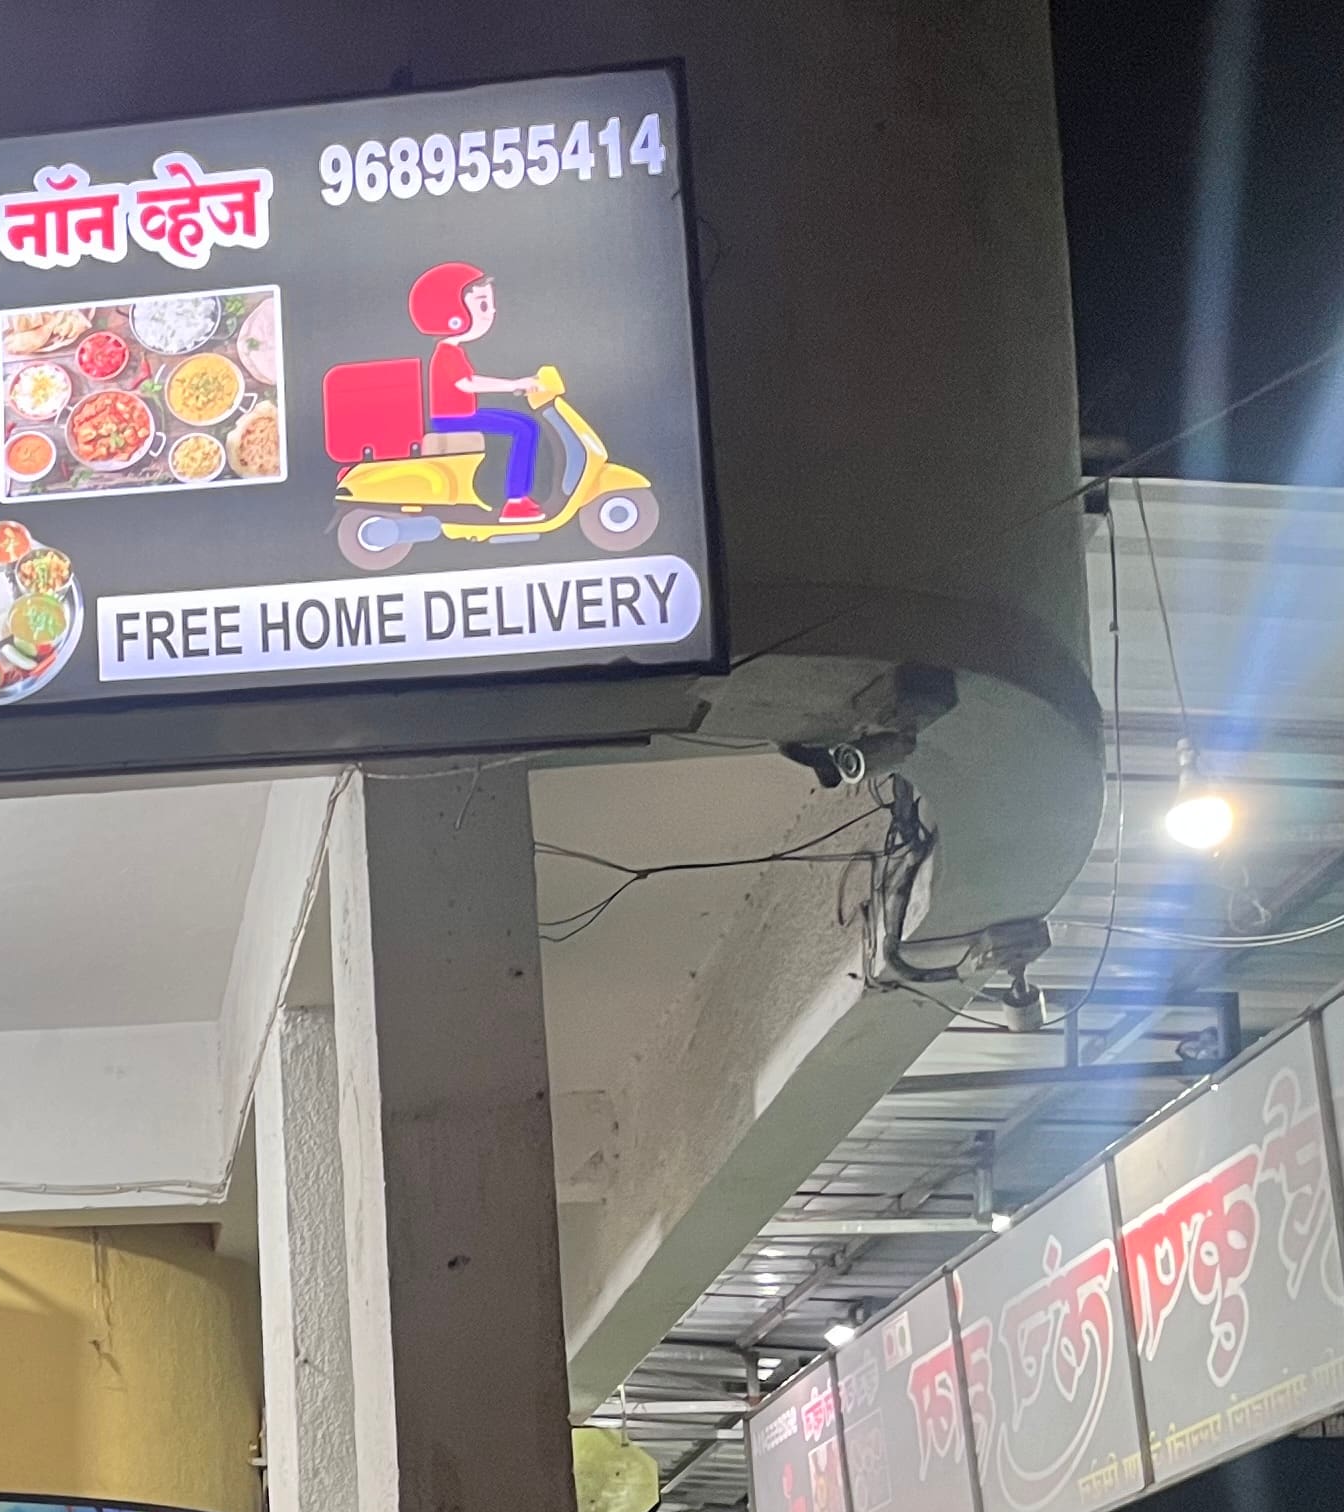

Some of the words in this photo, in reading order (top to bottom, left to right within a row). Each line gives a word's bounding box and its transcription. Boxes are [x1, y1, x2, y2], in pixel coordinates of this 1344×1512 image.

[320, 113, 667, 206] 9689555414
[5, 175, 118, 260] नॉन
[137, 158, 263, 260] व्हेज
[114, 606, 243, 663] FREE
[261, 590, 405, 655] HOME
[424, 572, 679, 638] DELIVERY
